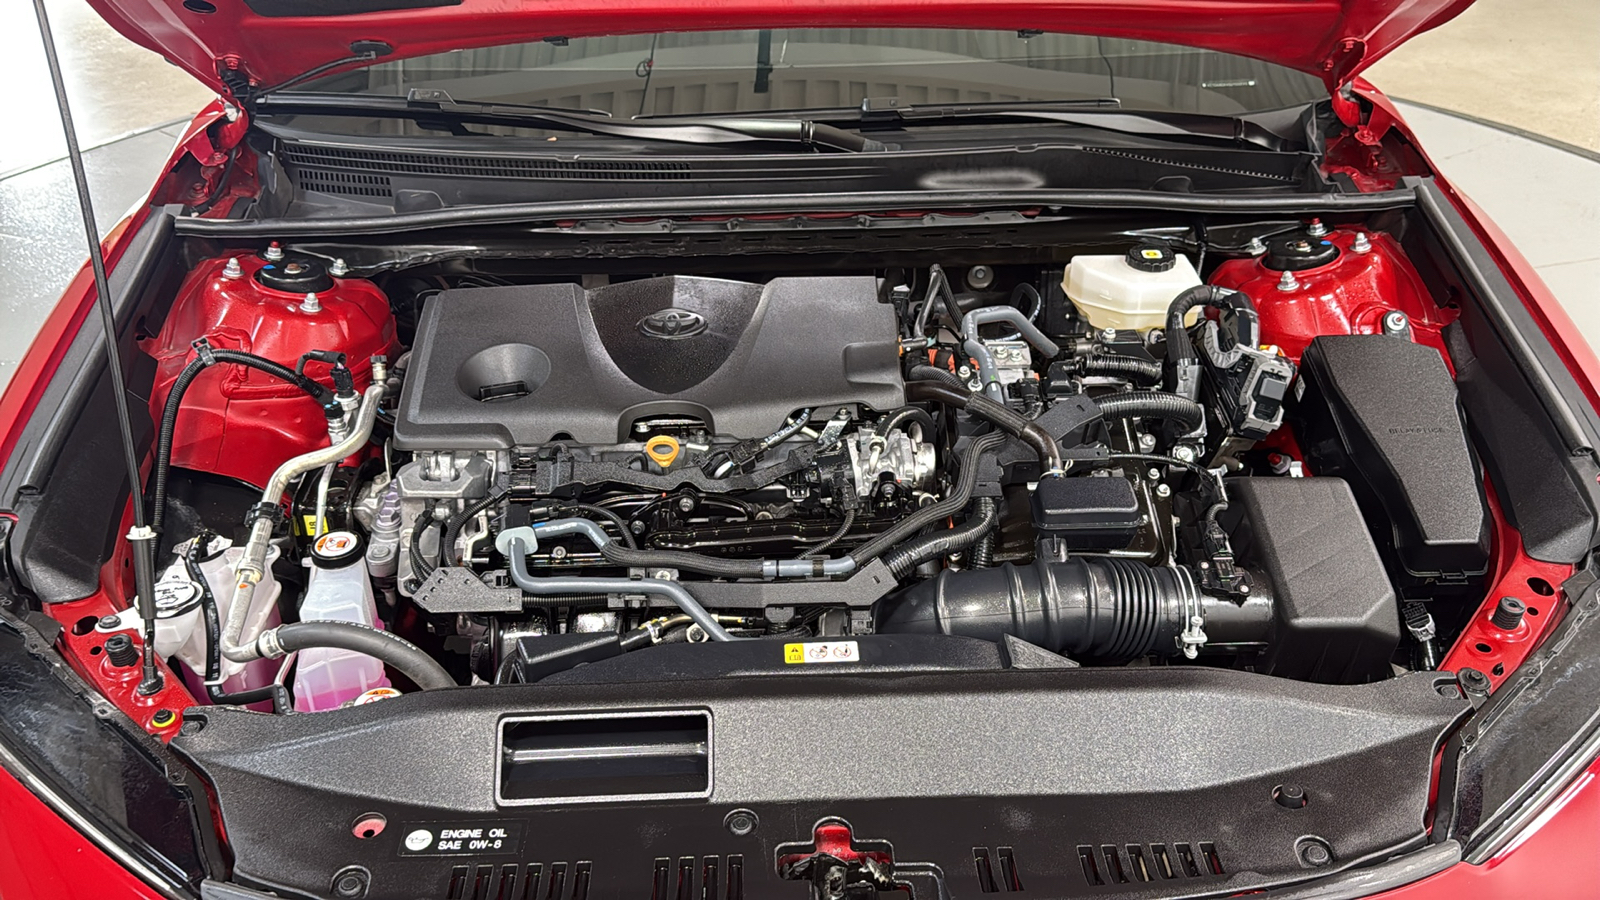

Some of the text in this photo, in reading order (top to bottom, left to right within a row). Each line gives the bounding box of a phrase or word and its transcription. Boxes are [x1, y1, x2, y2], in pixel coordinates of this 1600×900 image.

[440, 828, 508, 839] ENGINE OIL
[437, 839, 502, 850] SAE 0W-8
